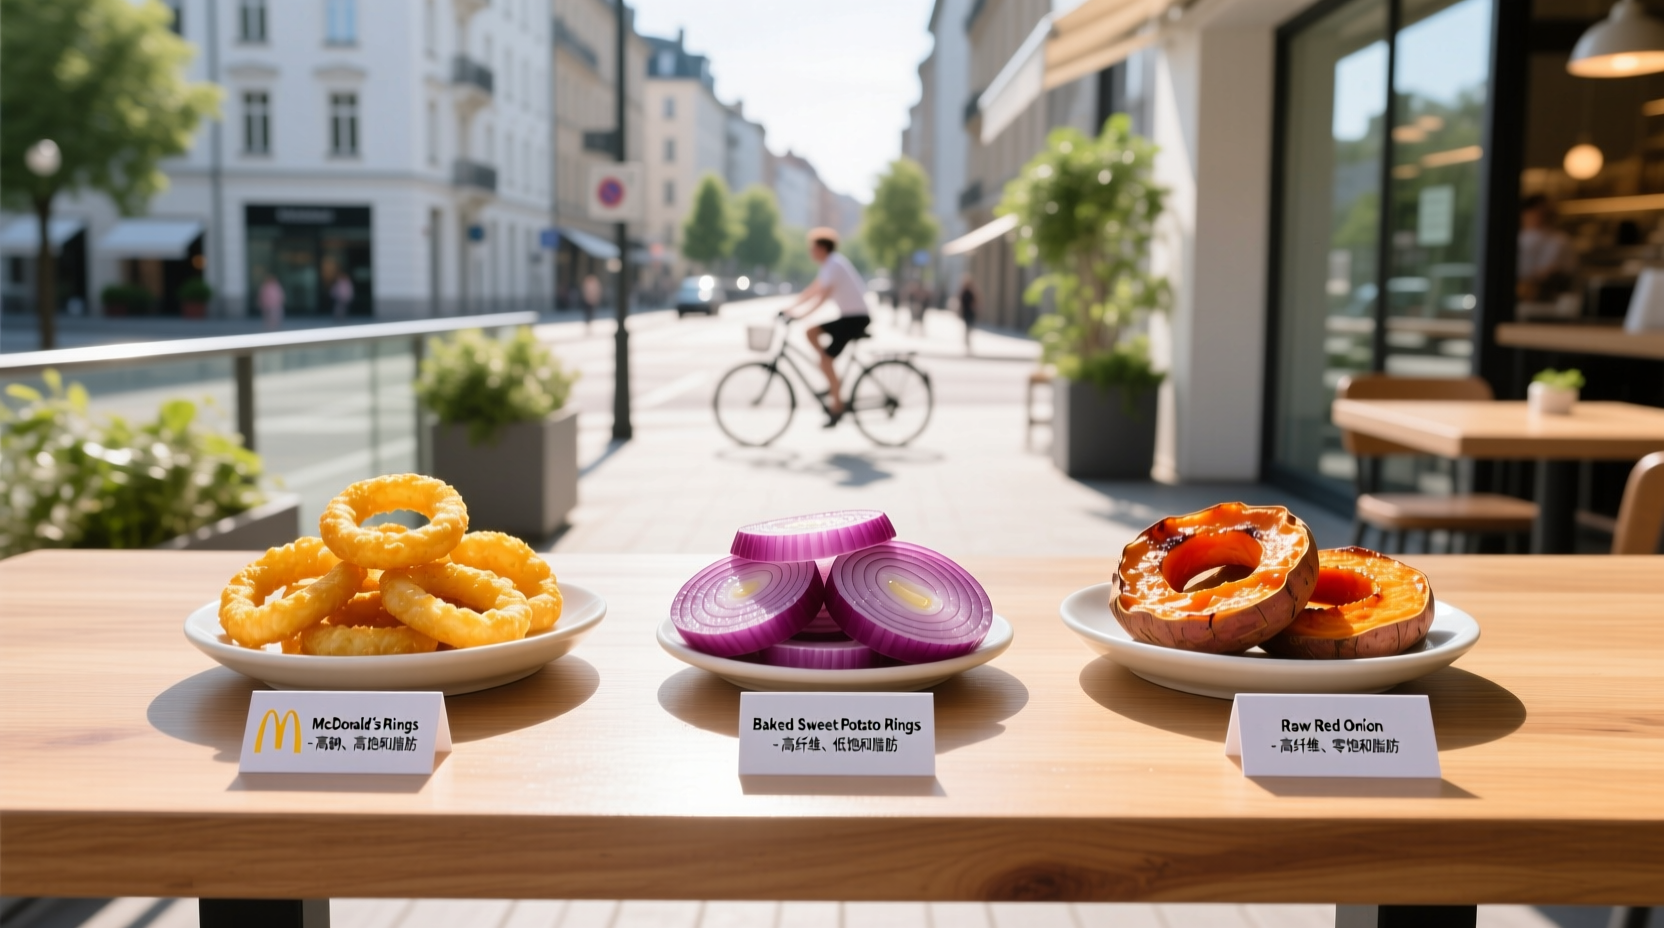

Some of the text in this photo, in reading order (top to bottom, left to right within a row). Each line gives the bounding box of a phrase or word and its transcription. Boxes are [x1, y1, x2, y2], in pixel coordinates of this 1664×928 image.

[254, 708, 302, 754] M
[312, 716, 419, 735] McDonald's Rings
[752, 717, 922, 736] Baked Sweet Potato Rings
[1281, 717, 1384, 732] Raw Red Onion
